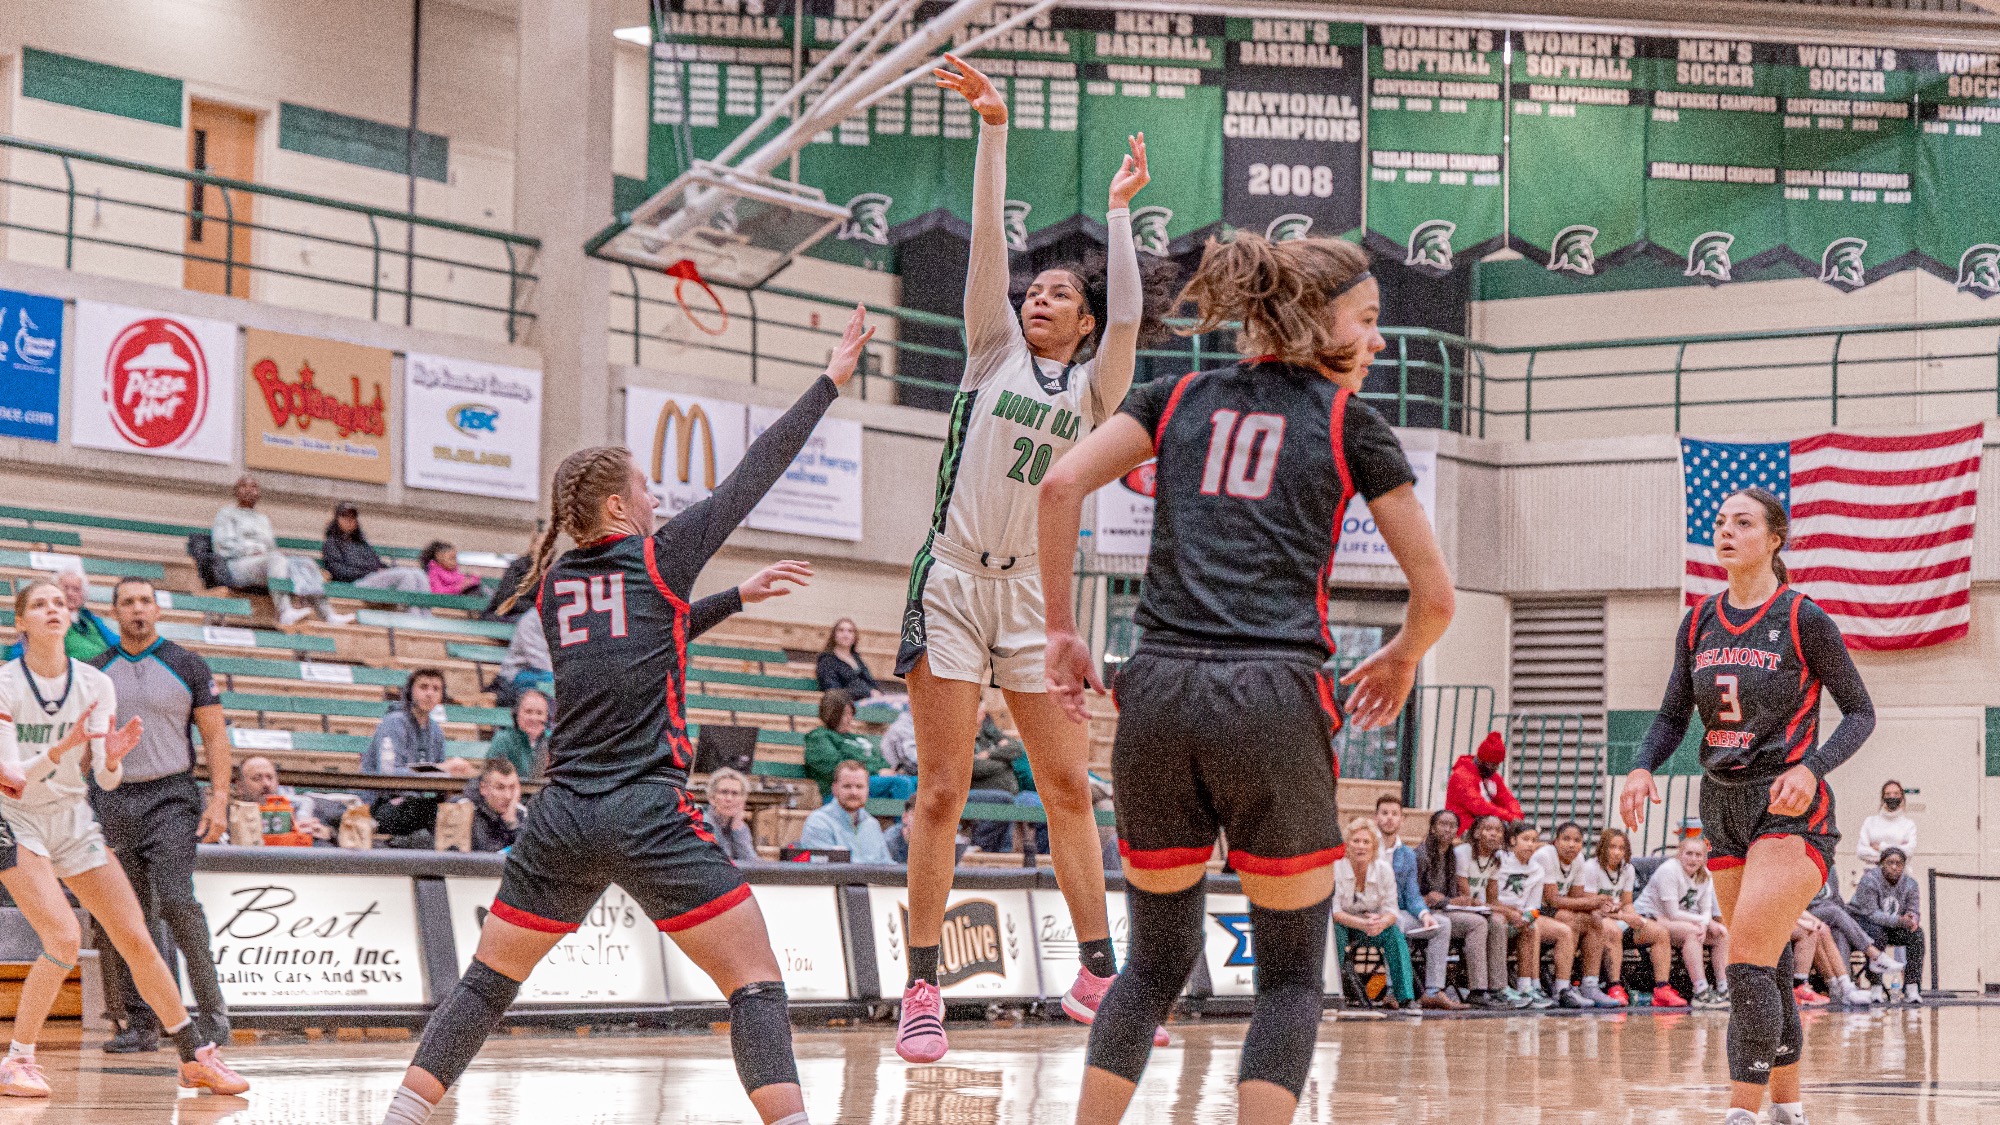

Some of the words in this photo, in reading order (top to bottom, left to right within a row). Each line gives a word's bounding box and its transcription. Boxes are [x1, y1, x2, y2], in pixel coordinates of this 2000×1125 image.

[1115, 11, 1193, 36] MEN'S
[1253, 19, 1329, 44] MEN'S
[1095, 33, 1211, 61] BASEBALL
[1380, 26, 1493, 52] WOMEN'S
[1523, 31, 1635, 58] WOMEN'S
[1678, 40, 1753, 64] MEN'S
[1239, 41, 1343, 69] BASEBALL
[1383, 48, 1490, 75] SOFTBALL
[1526, 54, 1632, 81] SOFTBALL
[1798, 45, 1896, 70] WOMEN'S
[1676, 62, 1754, 87] SOCCER
[1808, 69, 1885, 93] SOCCER
[1227, 91, 1358, 117] NATIONAL
[1223, 114, 1361, 142] CHAMPIONS
[1247, 164, 1333, 198] 2008
[133, 394, 186, 427] Hut
[992, 389, 1052, 430] MOUNT
[1006, 436, 1052, 486] 20
[1200, 407, 1287, 500] 10
[553, 571, 628, 648] 24
[1694, 648, 1781, 672] BELMONT
[1715, 674, 1742, 722] 3
[215, 885, 381, 939] Best
[238, 946, 341, 967] Clinton,
[353, 947, 400, 965] Inc.
[941, 915, 998, 973] Olive
[784, 948, 813, 971] You
[217, 970, 263, 983] uality
[275, 971, 312, 983] Cars
[321, 970, 353, 983] And
[361, 970, 402, 983] SUVs
